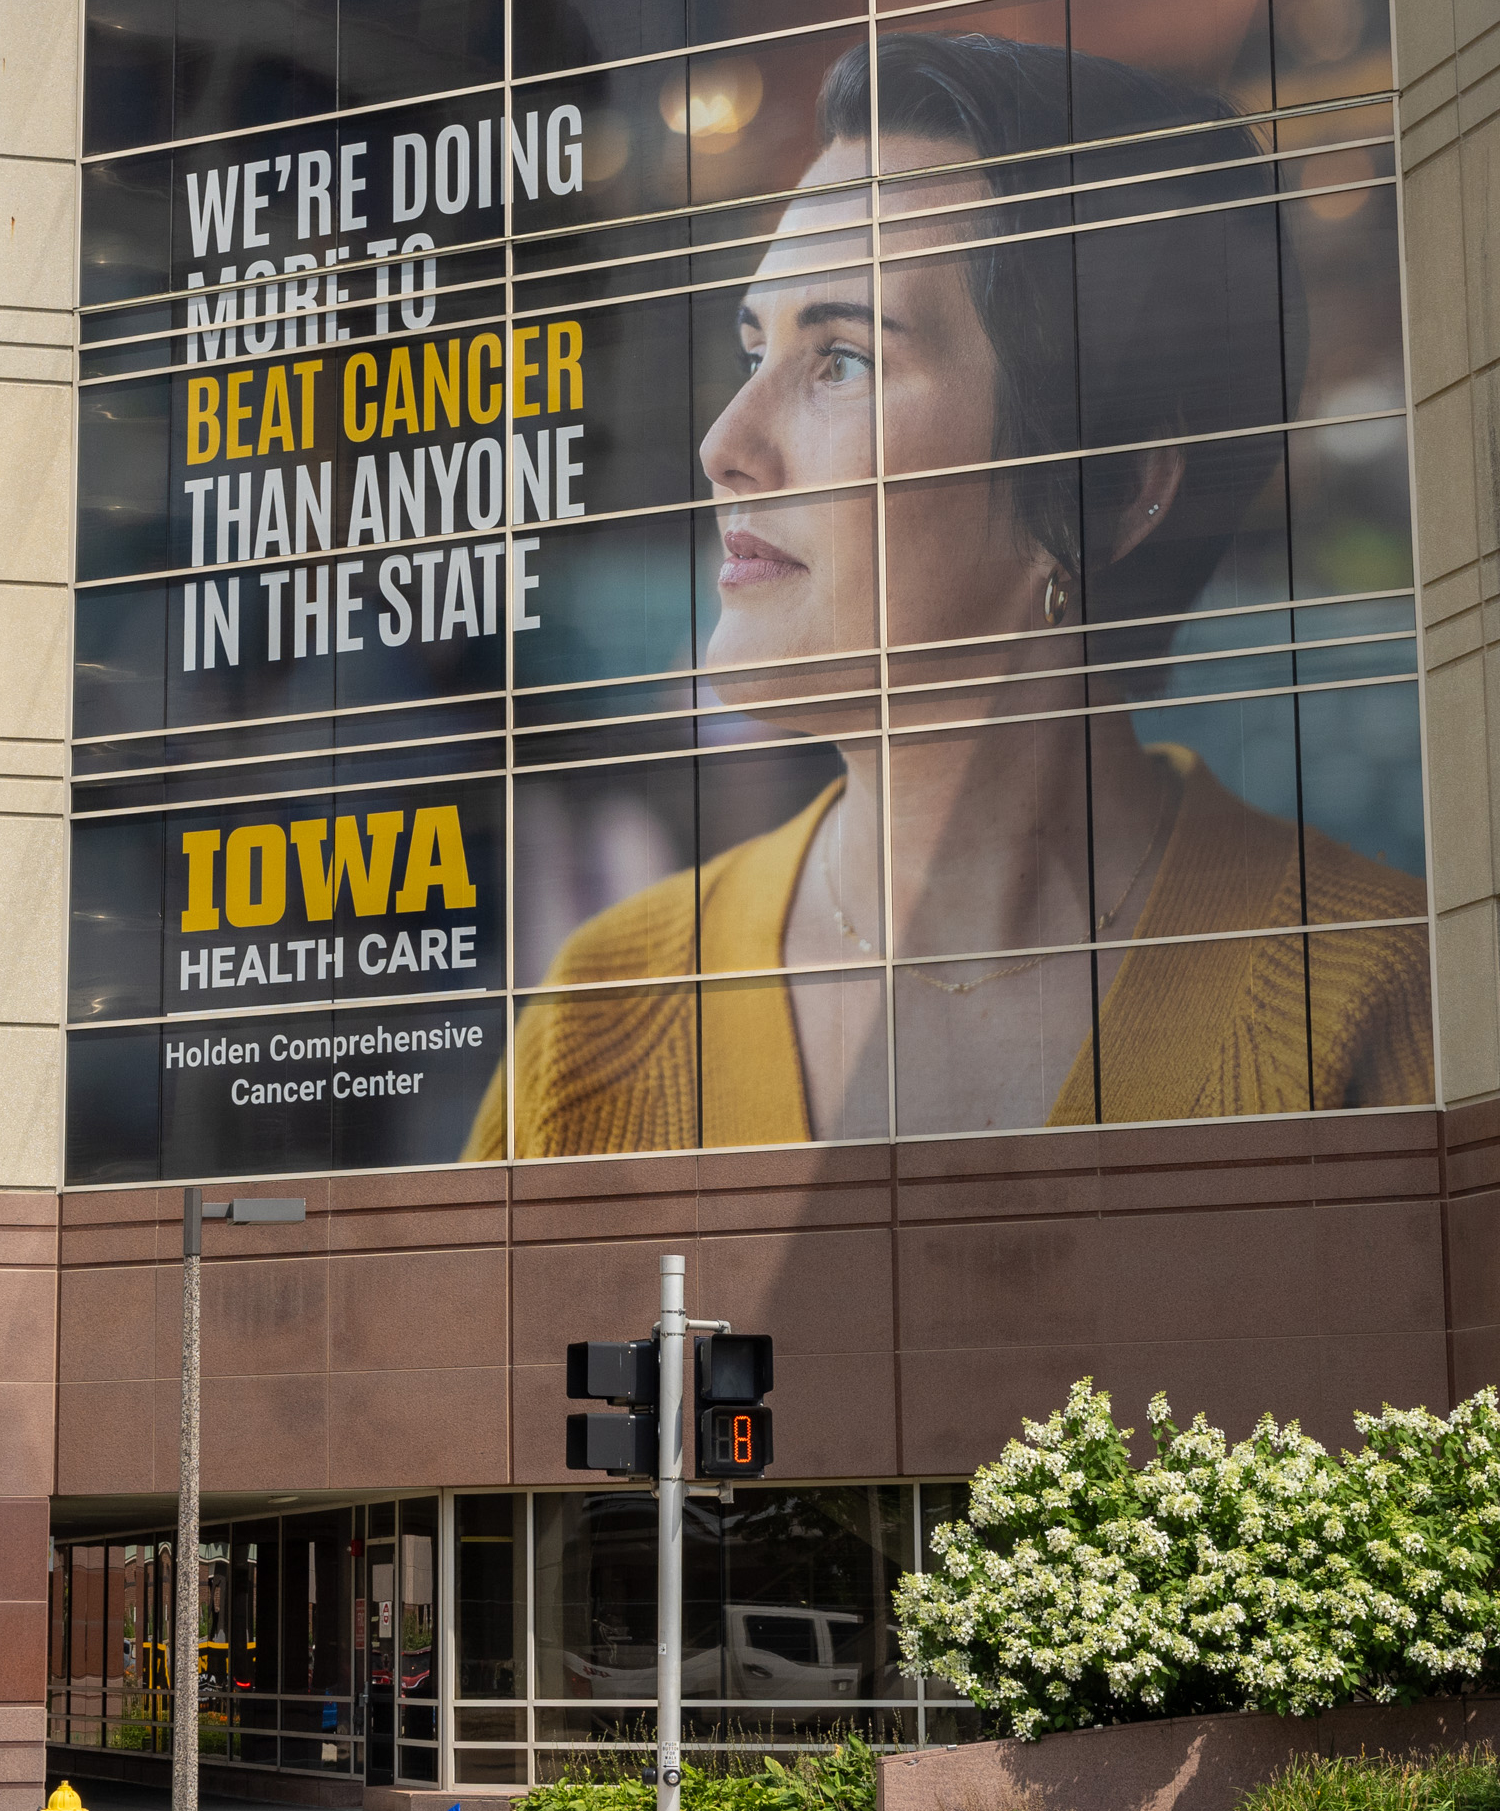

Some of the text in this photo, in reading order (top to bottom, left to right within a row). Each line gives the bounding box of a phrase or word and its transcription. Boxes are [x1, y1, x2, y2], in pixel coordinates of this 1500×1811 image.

[186, 104, 583, 257] WE'RE DOING
[187, 233, 437, 364] MORE TO
[186, 320, 584, 465] BEAT CANCER
[184, 424, 585, 567] THAN ANYONE
[183, 538, 541, 672] IN THE STATE
[181, 805, 476, 933] IOWA
[179, 926, 477, 991] HEALTH CARE
[165, 1021, 483, 1069] Holden Comprehensive
[230, 1069, 424, 1106] Cancer Center
[734, 1415, 751, 1462] 8
